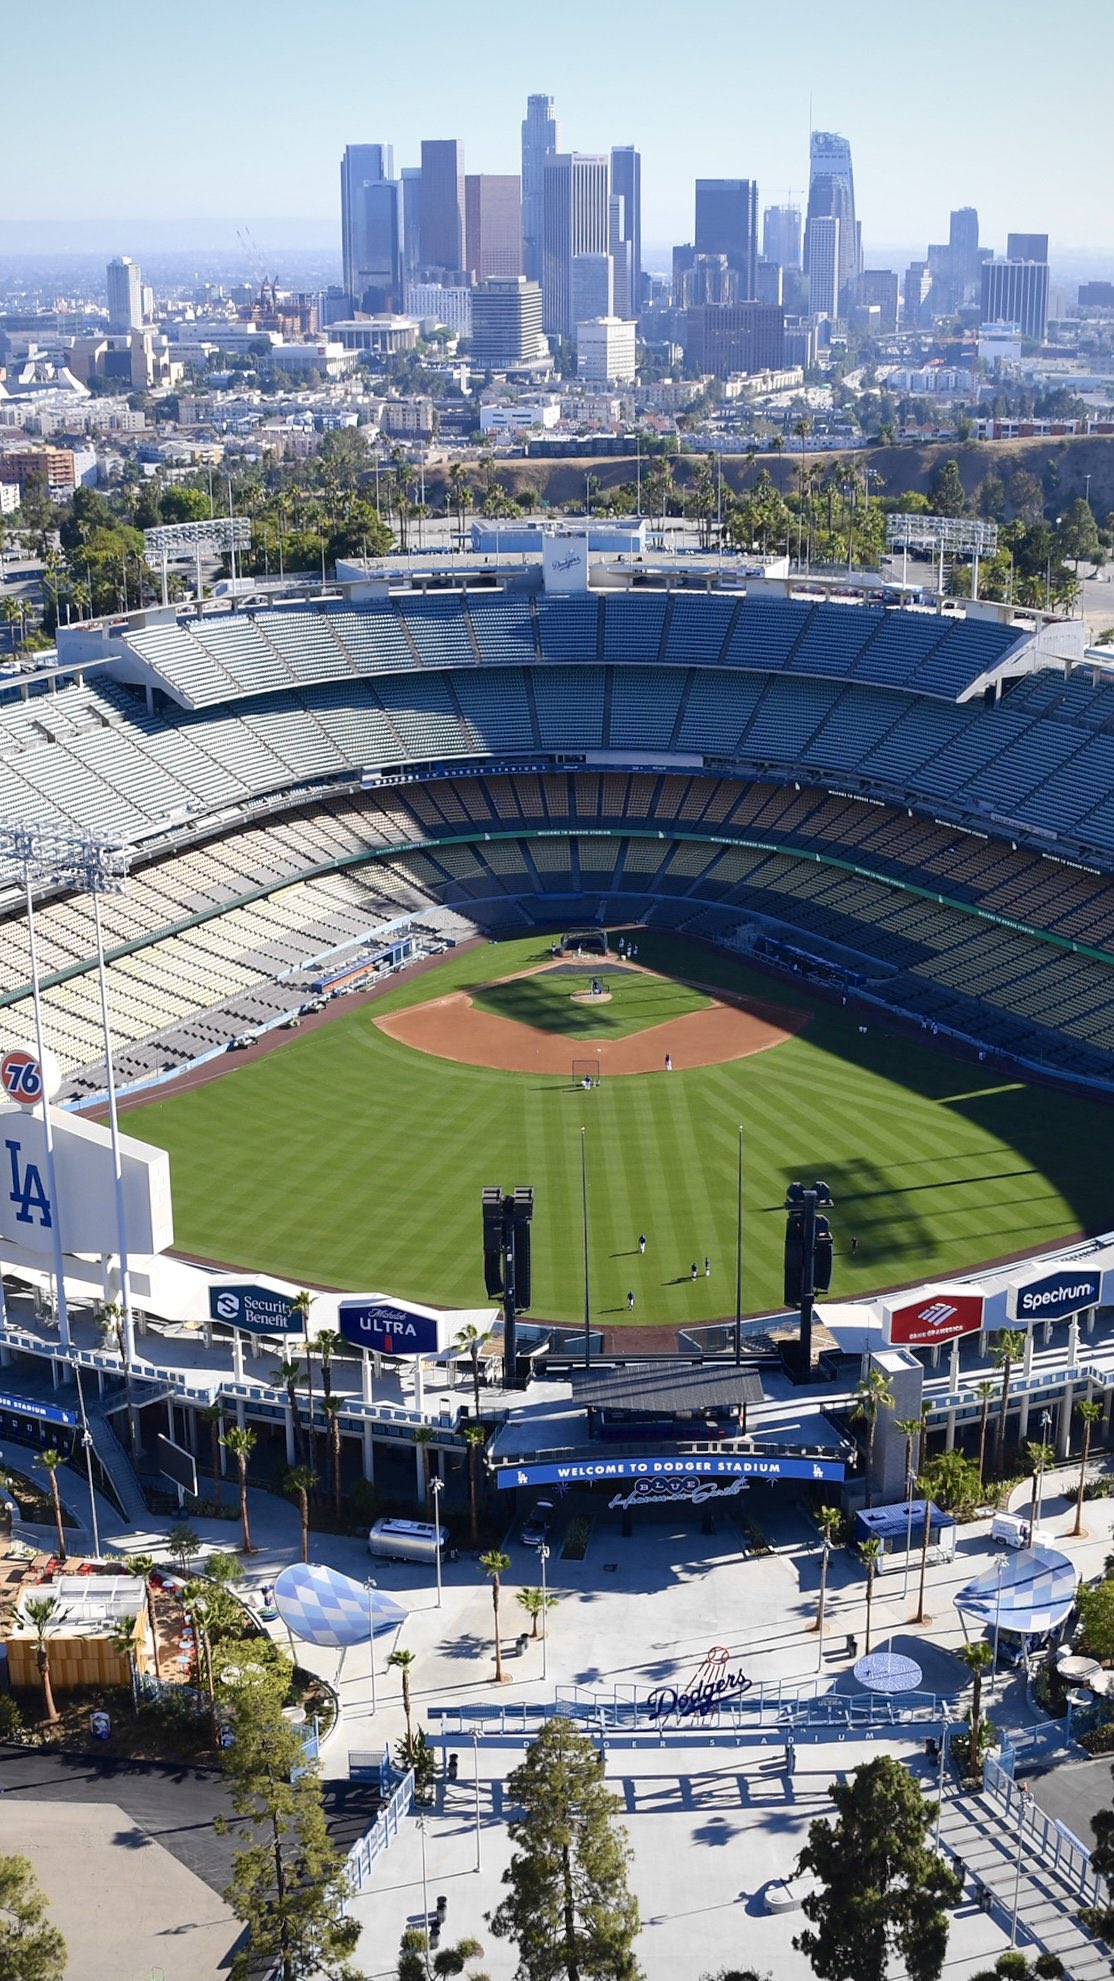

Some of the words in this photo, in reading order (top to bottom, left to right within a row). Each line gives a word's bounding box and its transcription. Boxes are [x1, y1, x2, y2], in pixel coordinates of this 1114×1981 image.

[6, 1063, 42, 1096] 76
[5, 1139, 52, 1228] LA
[244, 1296, 294, 1316] Security
[1023, 1283, 1091, 1311] Spectrum
[245, 1309, 289, 1328] Benefit
[368, 1307, 407, 1321] Michelob
[360, 1317, 416, 1337] ULTRA
[13, 1401, 47, 1415] STADIUM
[517, 1470, 528, 1484] LA
[558, 1464, 624, 1478] WELCOME
[630, 1462, 648, 1473] TO
[653, 1461, 712, 1472] DODGER
[718, 1461, 780, 1473] STADIUM
[813, 1463, 824, 1478] LA
[647, 1668, 752, 1721] Dodgers
[523, 1739, 667, 1748] DGER
[709, 1732, 875, 1747] STADIUM
